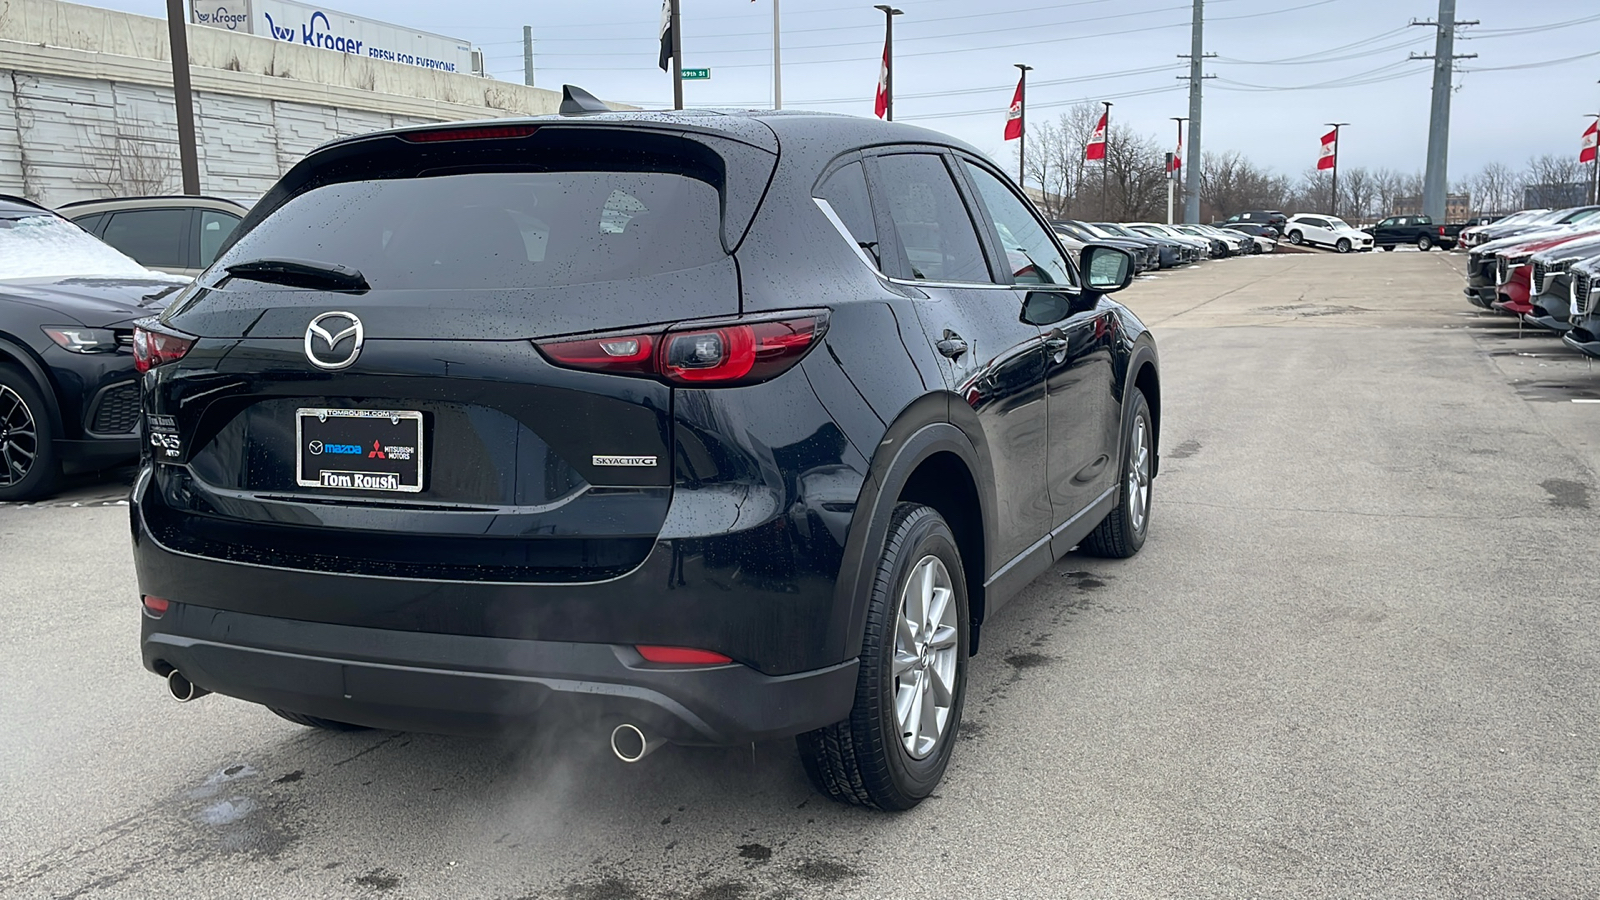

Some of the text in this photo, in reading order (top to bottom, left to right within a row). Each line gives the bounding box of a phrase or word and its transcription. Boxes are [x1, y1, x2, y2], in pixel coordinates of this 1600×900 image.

[212, 7, 247, 30] Kroger
[368, 47, 456, 73] FRESH FOR EVERYONE
[150, 432, 180, 449] CX-5
[384, 446, 415, 454] MITSUBISHI
[321, 472, 397, 489] Tom Roush
